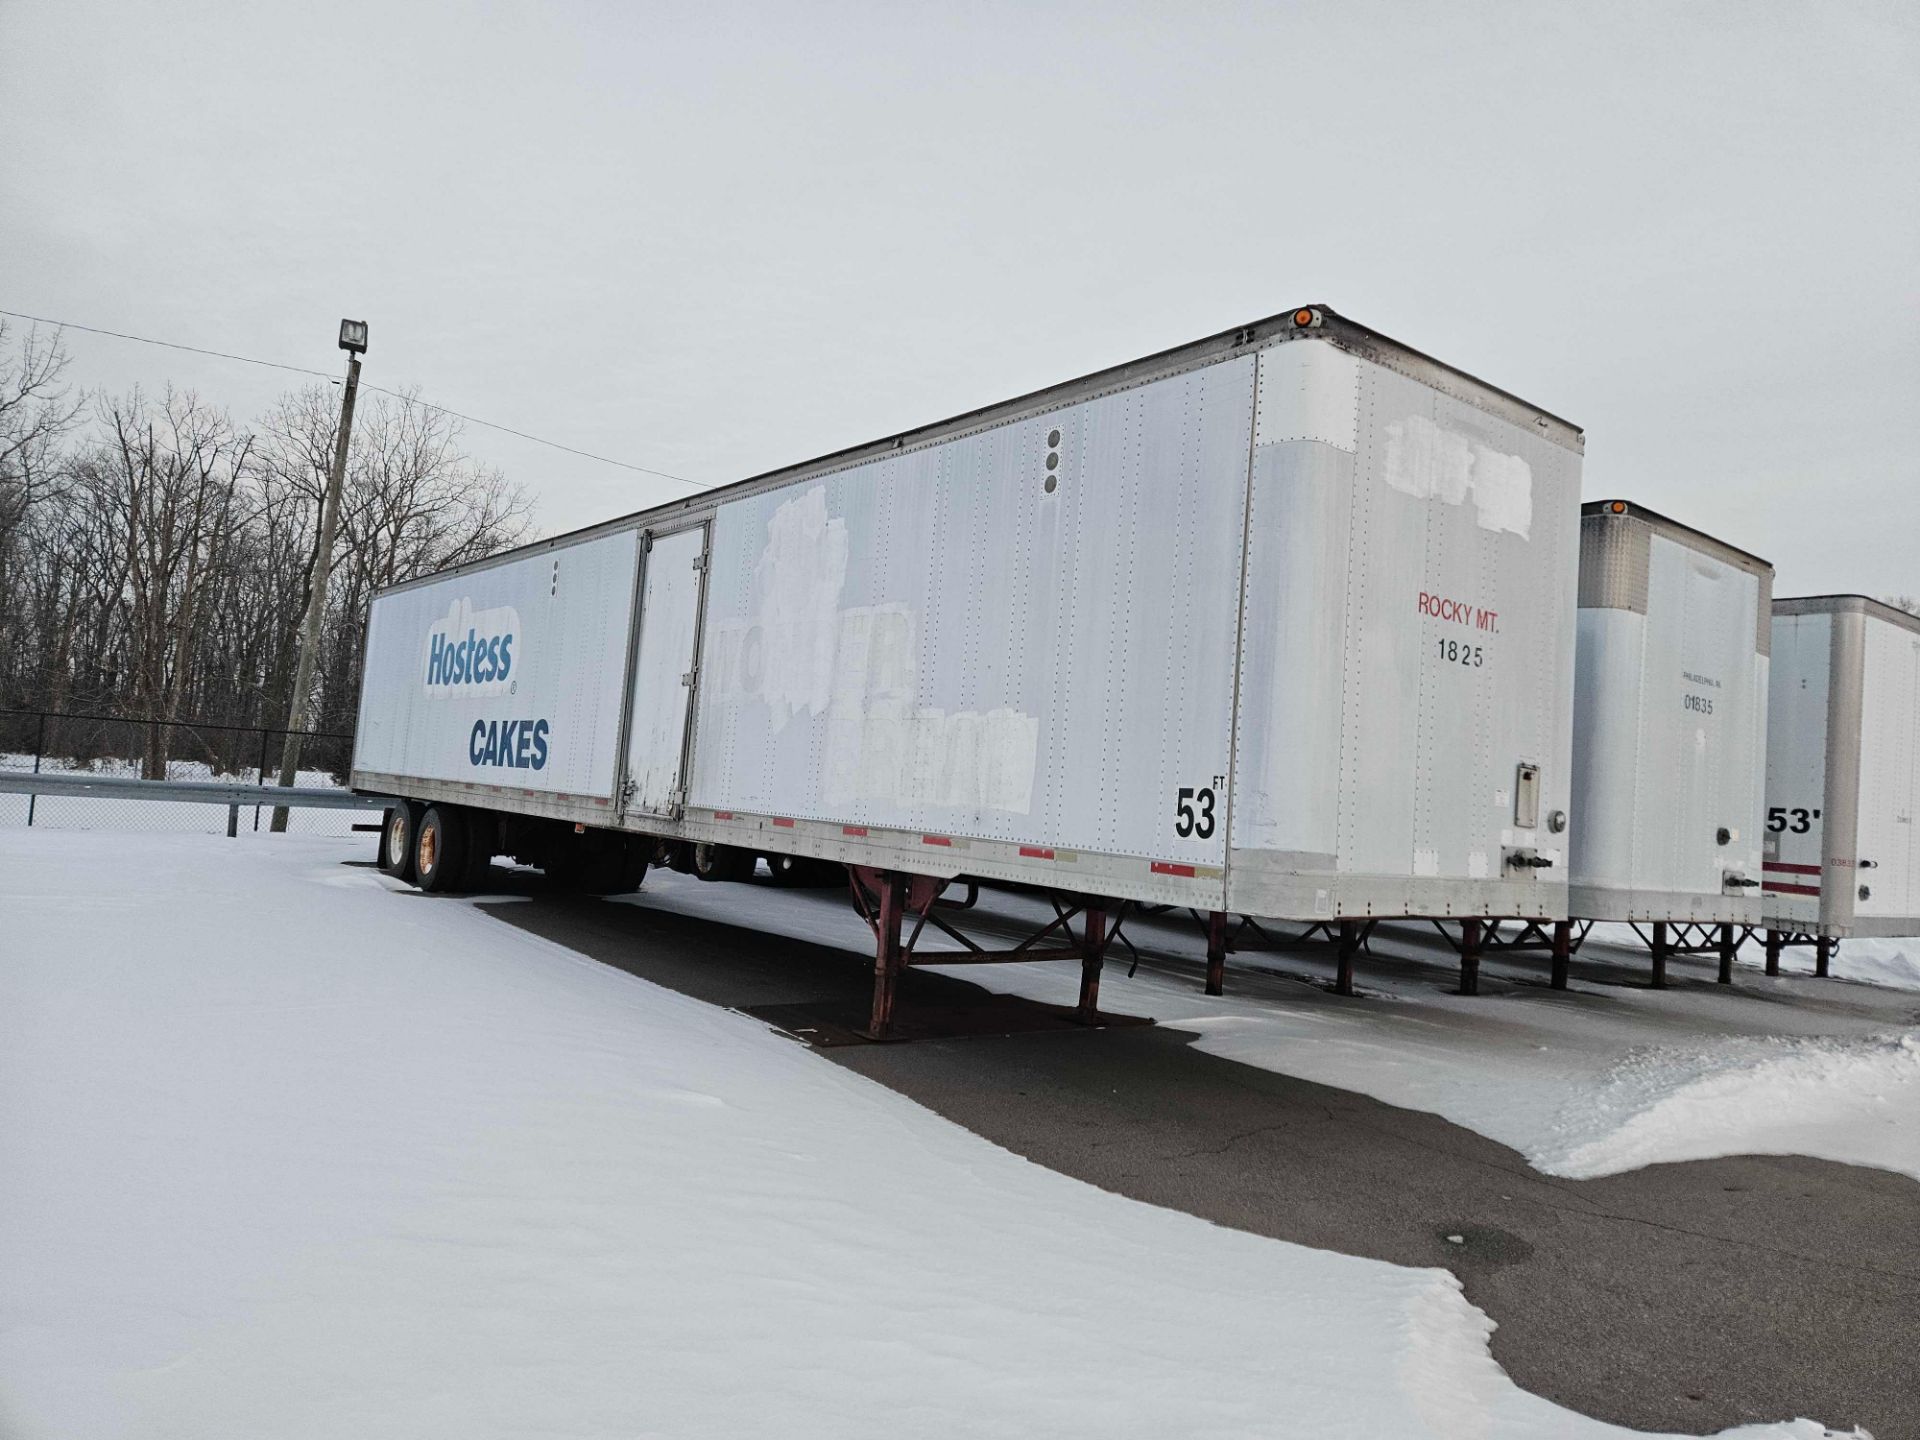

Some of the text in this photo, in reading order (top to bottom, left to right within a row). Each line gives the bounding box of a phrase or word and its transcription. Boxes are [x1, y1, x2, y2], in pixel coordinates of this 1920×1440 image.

[1418, 591, 1500, 634] ROCKY MT.
[427, 628, 513, 686] Hostess
[1439, 638, 1483, 667] 1825
[1684, 694, 1713, 715] 01835
[469, 718, 549, 771] CAKES
[1175, 775, 1225, 840] 53 FT
[1767, 807, 1821, 834] 53'
